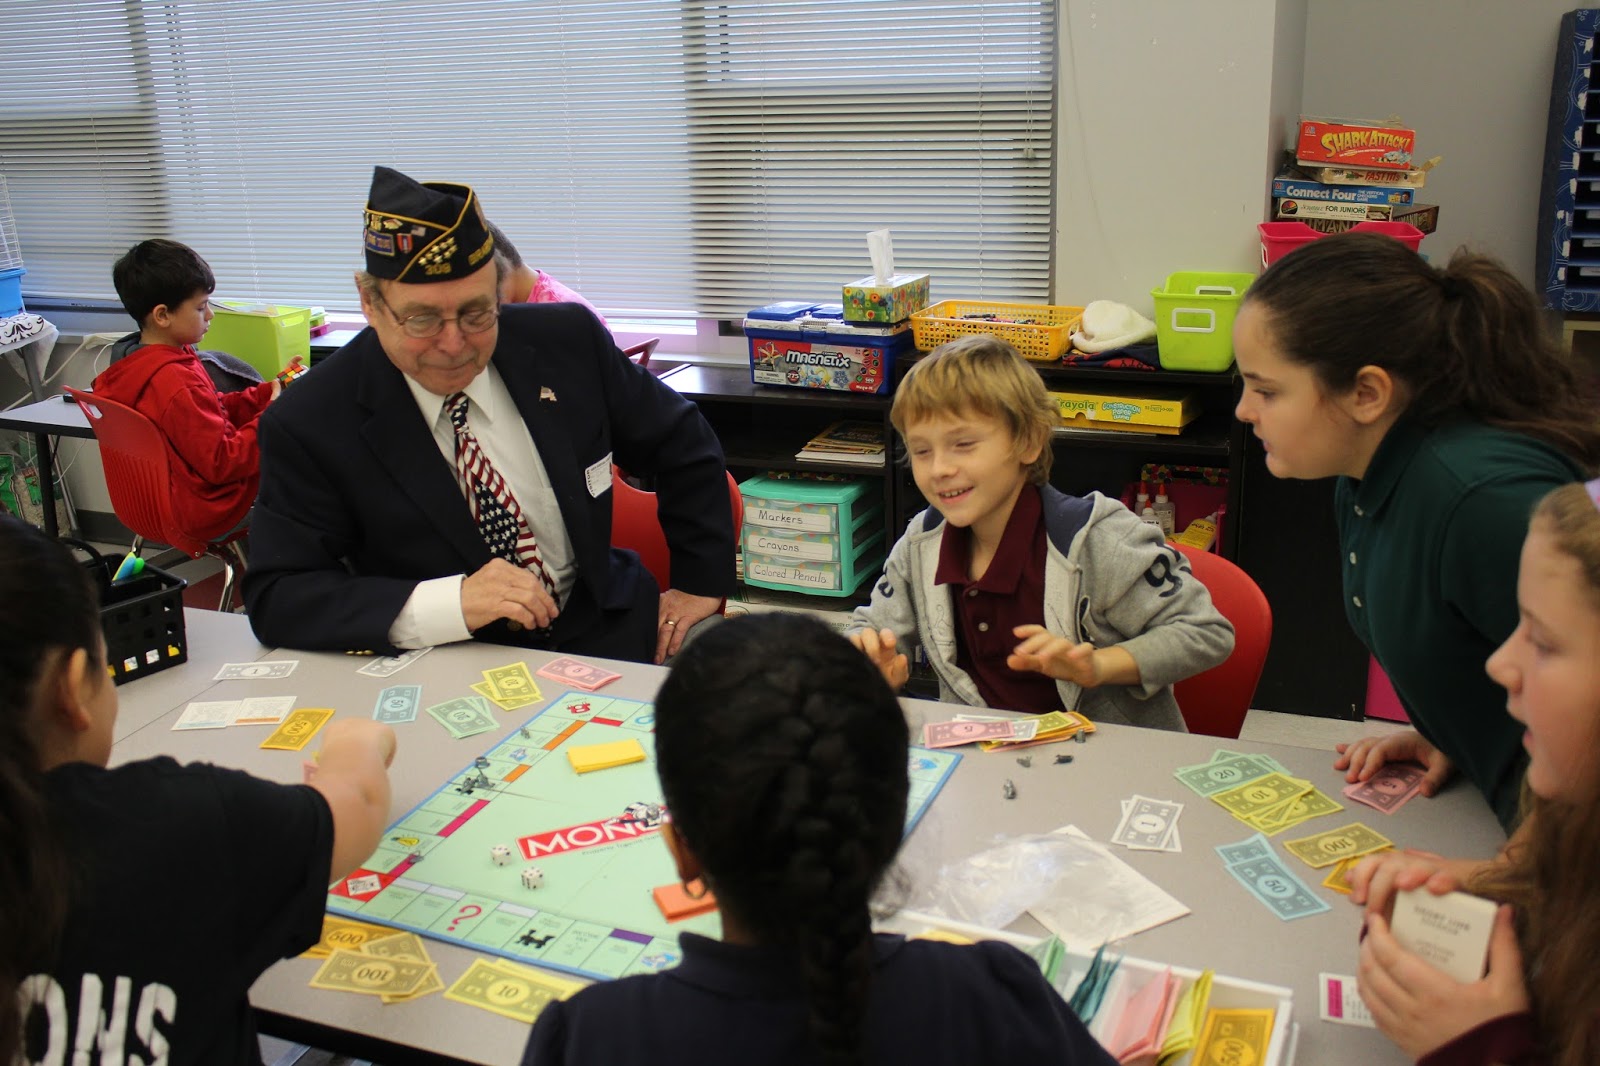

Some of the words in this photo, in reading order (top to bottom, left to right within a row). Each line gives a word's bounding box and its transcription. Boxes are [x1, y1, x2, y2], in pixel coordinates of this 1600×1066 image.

[1321, 131, 1371, 158] SHARK
[1365, 171, 1385, 181] FAST
[1286, 185, 1330, 199] Connect
[1332, 189, 1356, 201] Four
[1339, 206, 1366, 214] JUNIORS
[758, 510, 803, 525] Markers
[757, 538, 800, 552] Crayons
[754, 564, 787, 579] Colored
[793, 569, 827, 584] Pencils
[1214, 768, 1235, 780] 20
[1251, 790, 1270, 800] 10
[1324, 837, 1354, 853] 100
[1264, 878, 1288, 894] 50
[328, 931, 363, 945] 500
[356, 965, 389, 982] 100
[498, 984, 519, 998] 10
